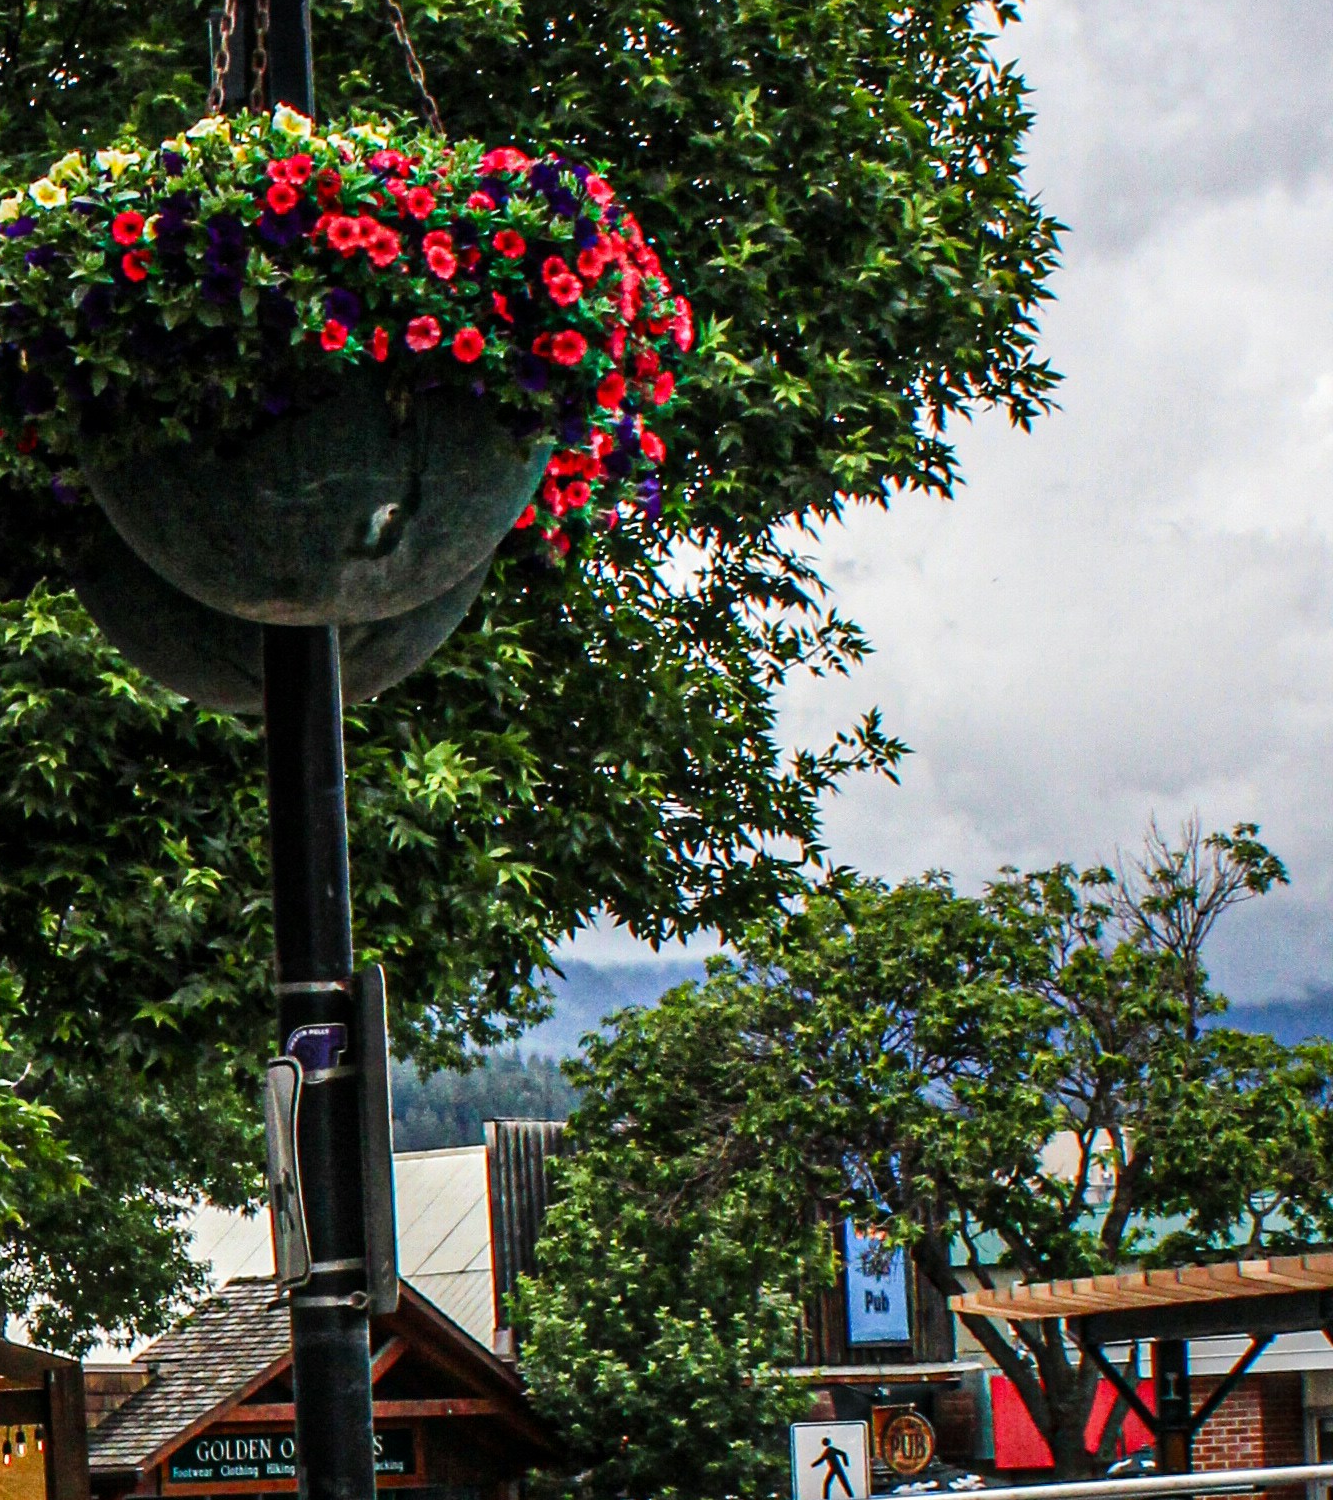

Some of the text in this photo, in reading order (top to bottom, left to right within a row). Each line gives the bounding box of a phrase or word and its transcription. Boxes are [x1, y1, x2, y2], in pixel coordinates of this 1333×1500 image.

[864, 1290, 890, 1314] Pub
[196, 1439, 272, 1462] GOLDEN
[890, 1434, 926, 1460] PUB
[173, 1466, 213, 1478] Footwear
[220, 1464, 259, 1478] Clothing
[266, 1463, 296, 1477] Hiking
